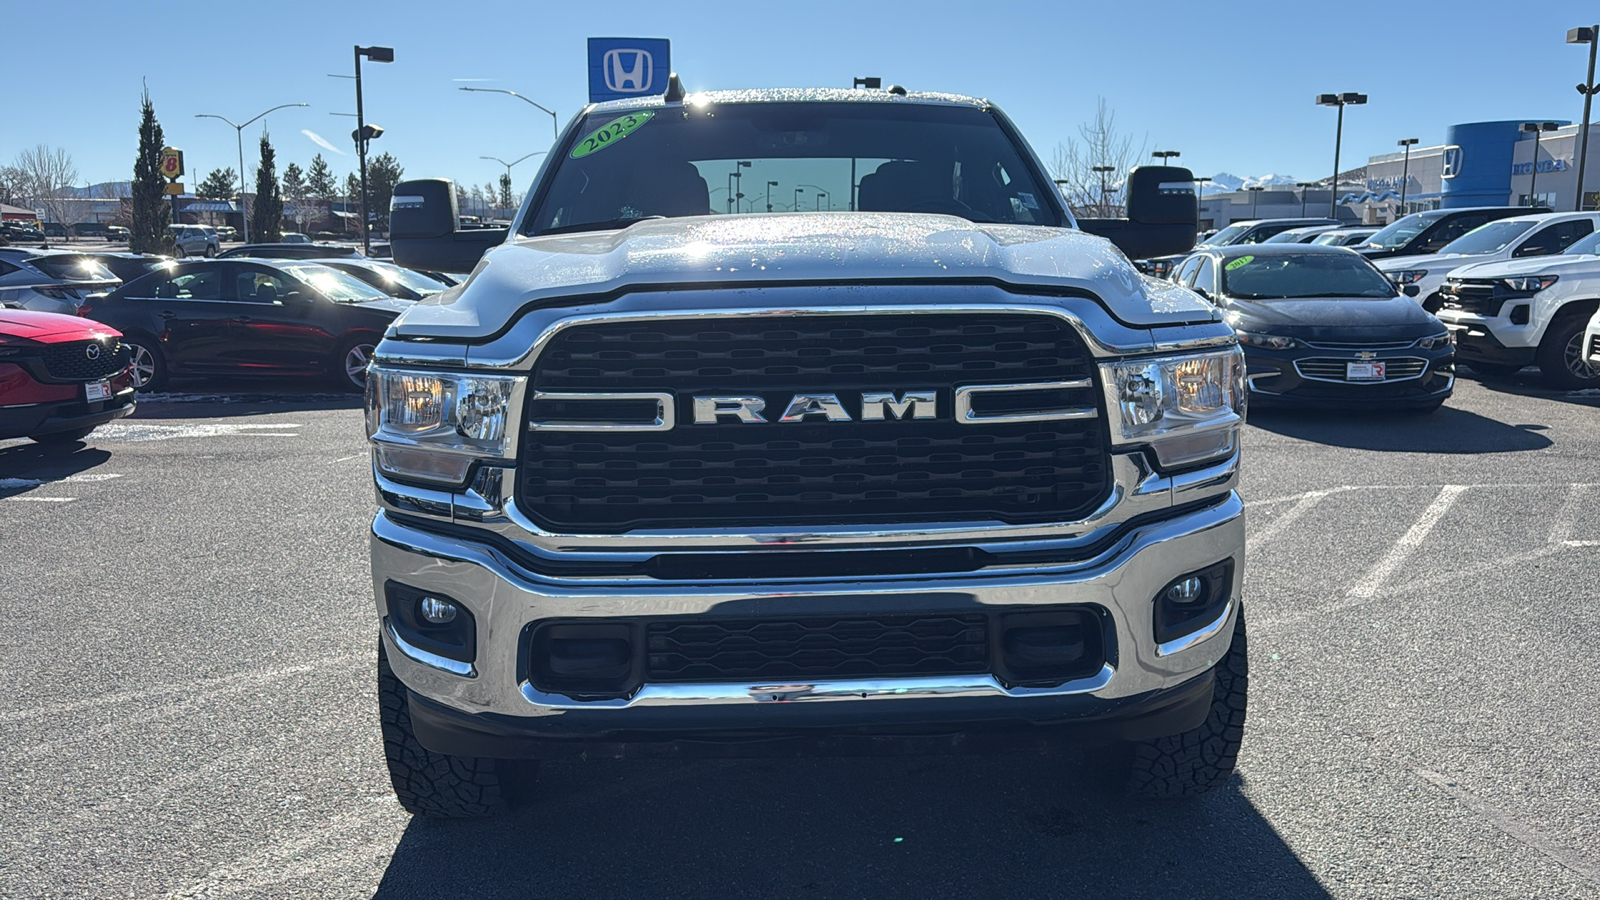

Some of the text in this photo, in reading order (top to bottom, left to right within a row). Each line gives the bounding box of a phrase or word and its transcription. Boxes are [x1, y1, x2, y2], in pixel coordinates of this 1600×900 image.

[583, 115, 638, 152] 2023
[165, 157, 178, 172] 8
[1512, 159, 1567, 175] HONDA
[1230, 257, 1248, 268] 2017
[692, 390, 938, 424] RAM
